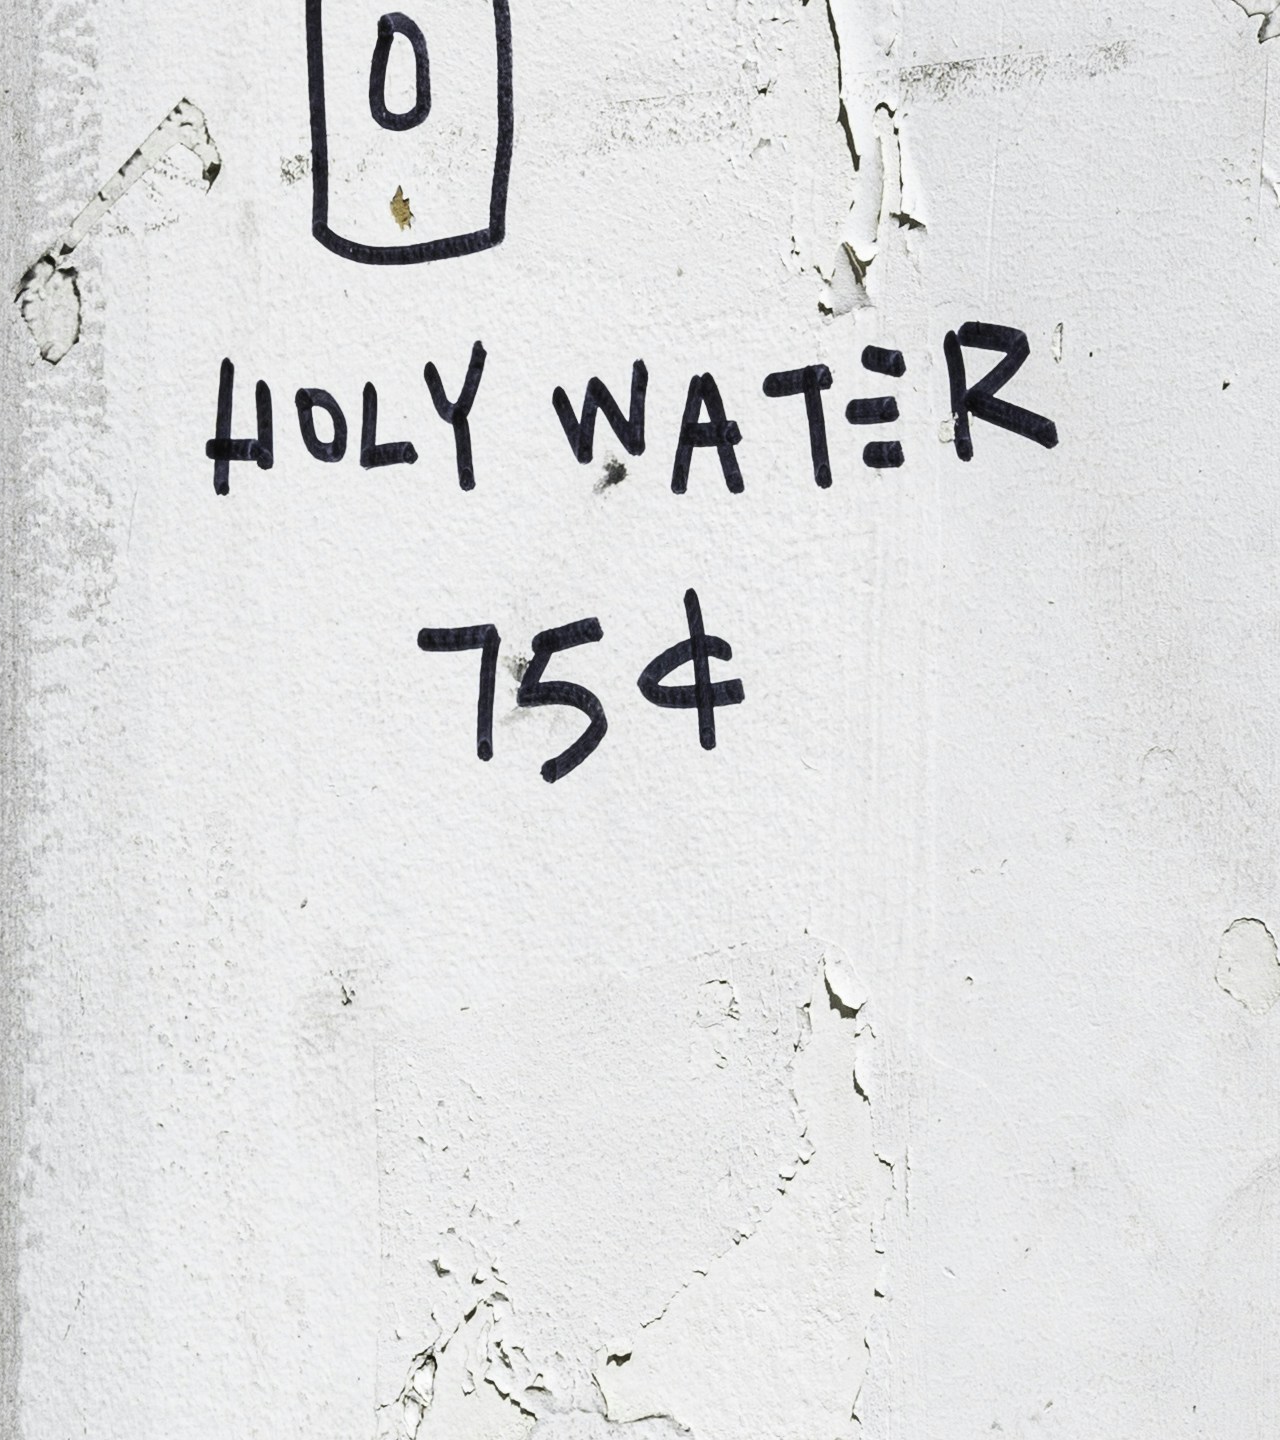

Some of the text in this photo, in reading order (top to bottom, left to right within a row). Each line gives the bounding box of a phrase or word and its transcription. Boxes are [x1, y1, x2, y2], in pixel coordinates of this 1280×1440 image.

[204, 321, 1059, 497] HOLY WATER
[417, 587, 745, 784] 75¢
